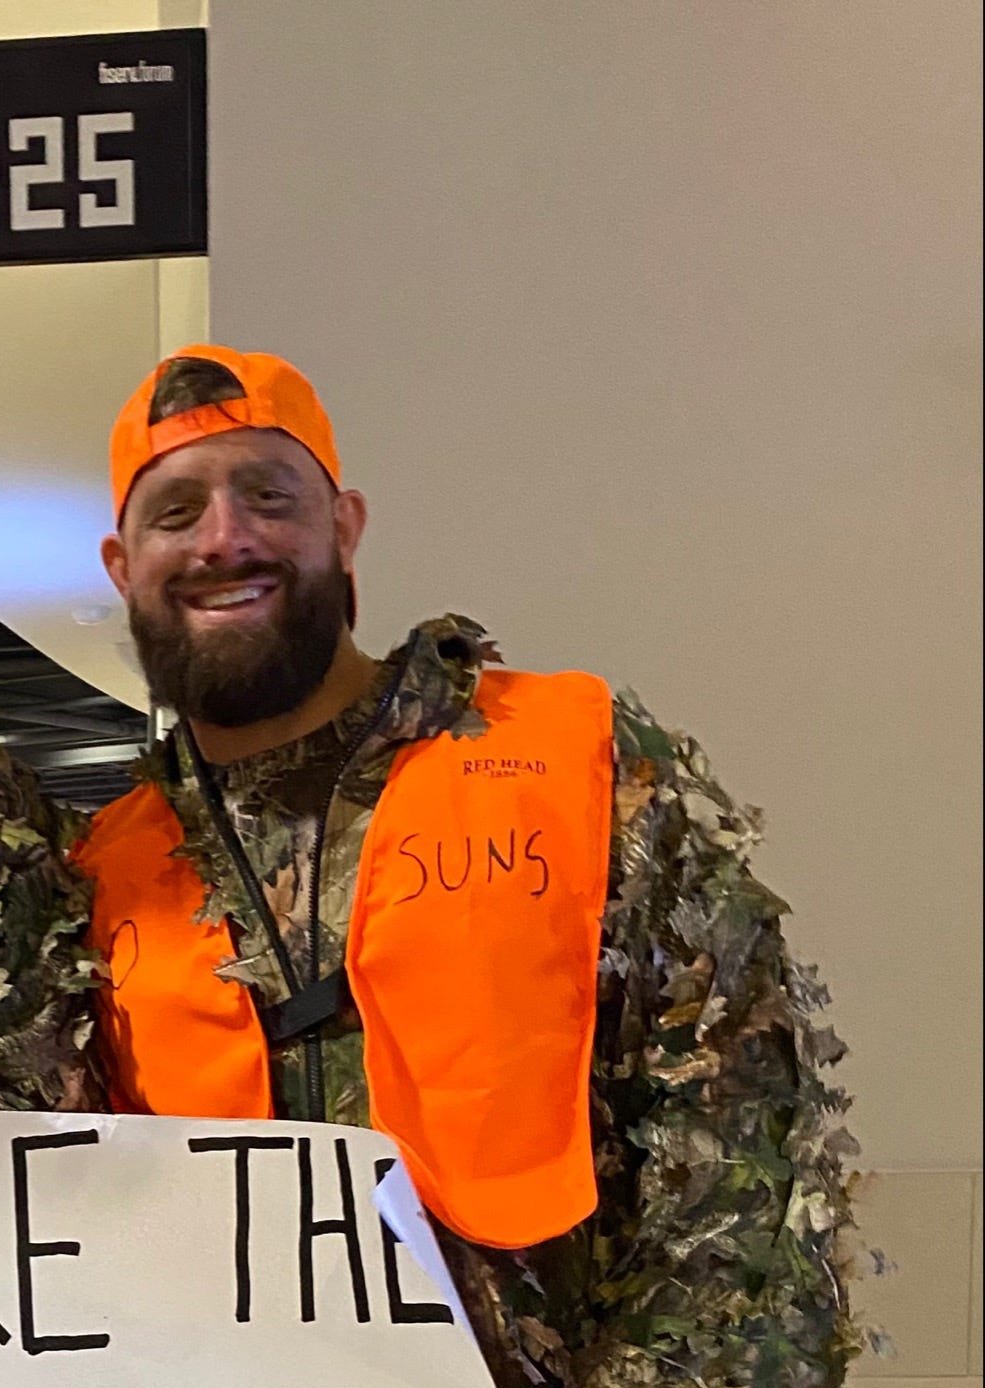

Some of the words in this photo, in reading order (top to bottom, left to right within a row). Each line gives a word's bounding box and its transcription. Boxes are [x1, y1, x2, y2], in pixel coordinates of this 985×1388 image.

[463, 759, 495, 776] RED
[500, 759, 546, 776] HEAD
[395, 828, 550, 905] SUNS
[188, 1135, 454, 1324] THE
